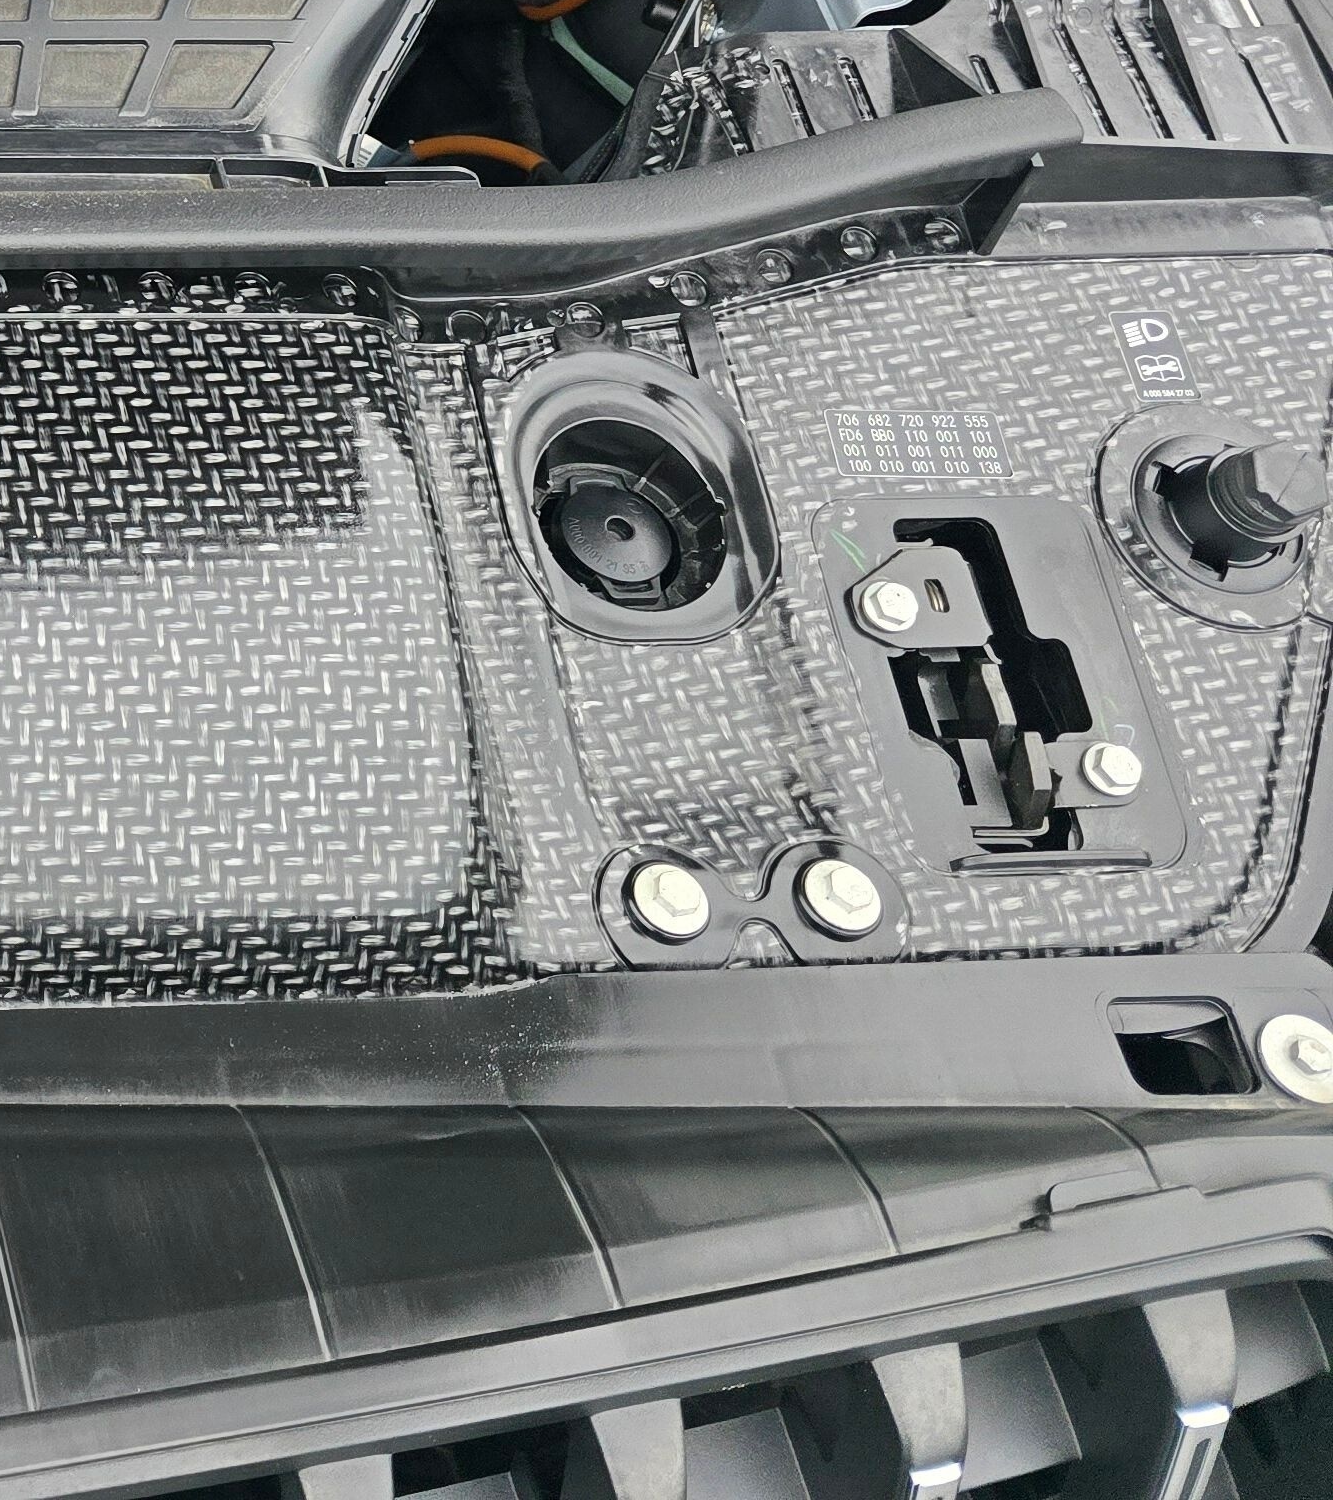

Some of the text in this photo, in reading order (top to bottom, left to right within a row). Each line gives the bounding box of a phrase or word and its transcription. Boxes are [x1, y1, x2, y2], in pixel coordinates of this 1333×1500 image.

[835, 414, 989, 428] 706 682 720 922 555
[839, 428, 992, 443] FD6 BB0 110 001 101
[844, 444, 997, 459] 001 011 001 011 000
[849, 460, 1002, 474] 100 010 001 010 138
